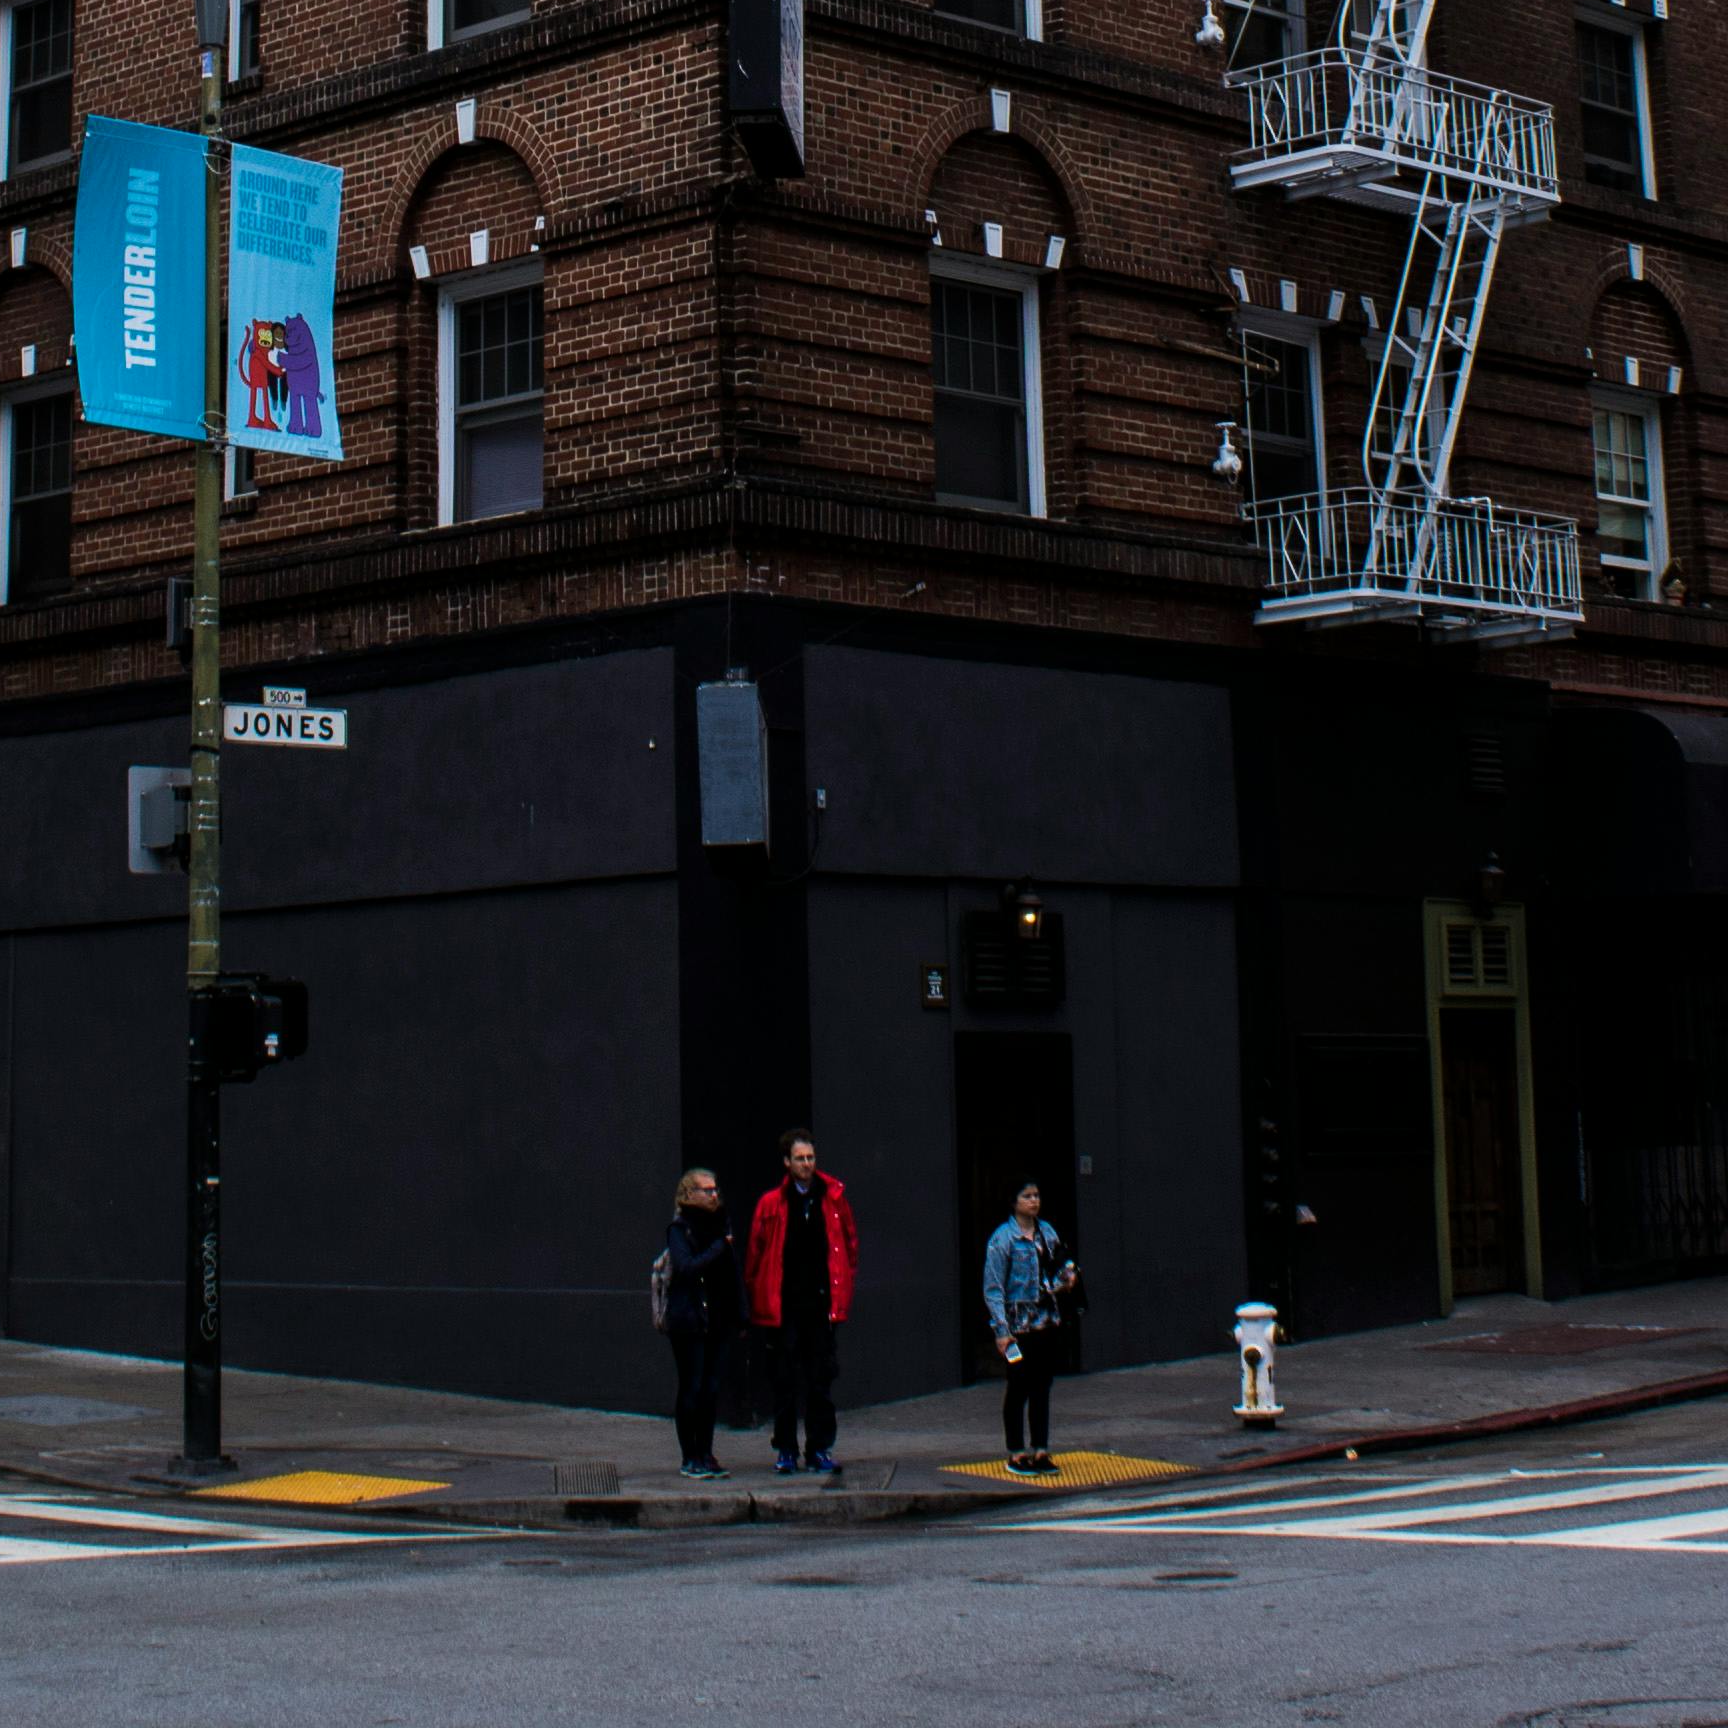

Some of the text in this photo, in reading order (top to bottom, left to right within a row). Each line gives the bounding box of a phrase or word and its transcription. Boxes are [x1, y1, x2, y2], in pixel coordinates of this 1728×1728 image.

[238, 170, 320, 205] AROUND HERE
[239, 190, 307, 223] WE TEND TO
[238, 210, 327, 250] CELEBRATE OUR
[238, 229, 315, 267] DIFFERENCES.
[124, 167, 160, 369] TENDERLOIN
[270, 690, 291, 704] 500
[234, 711, 334, 740] JONES
